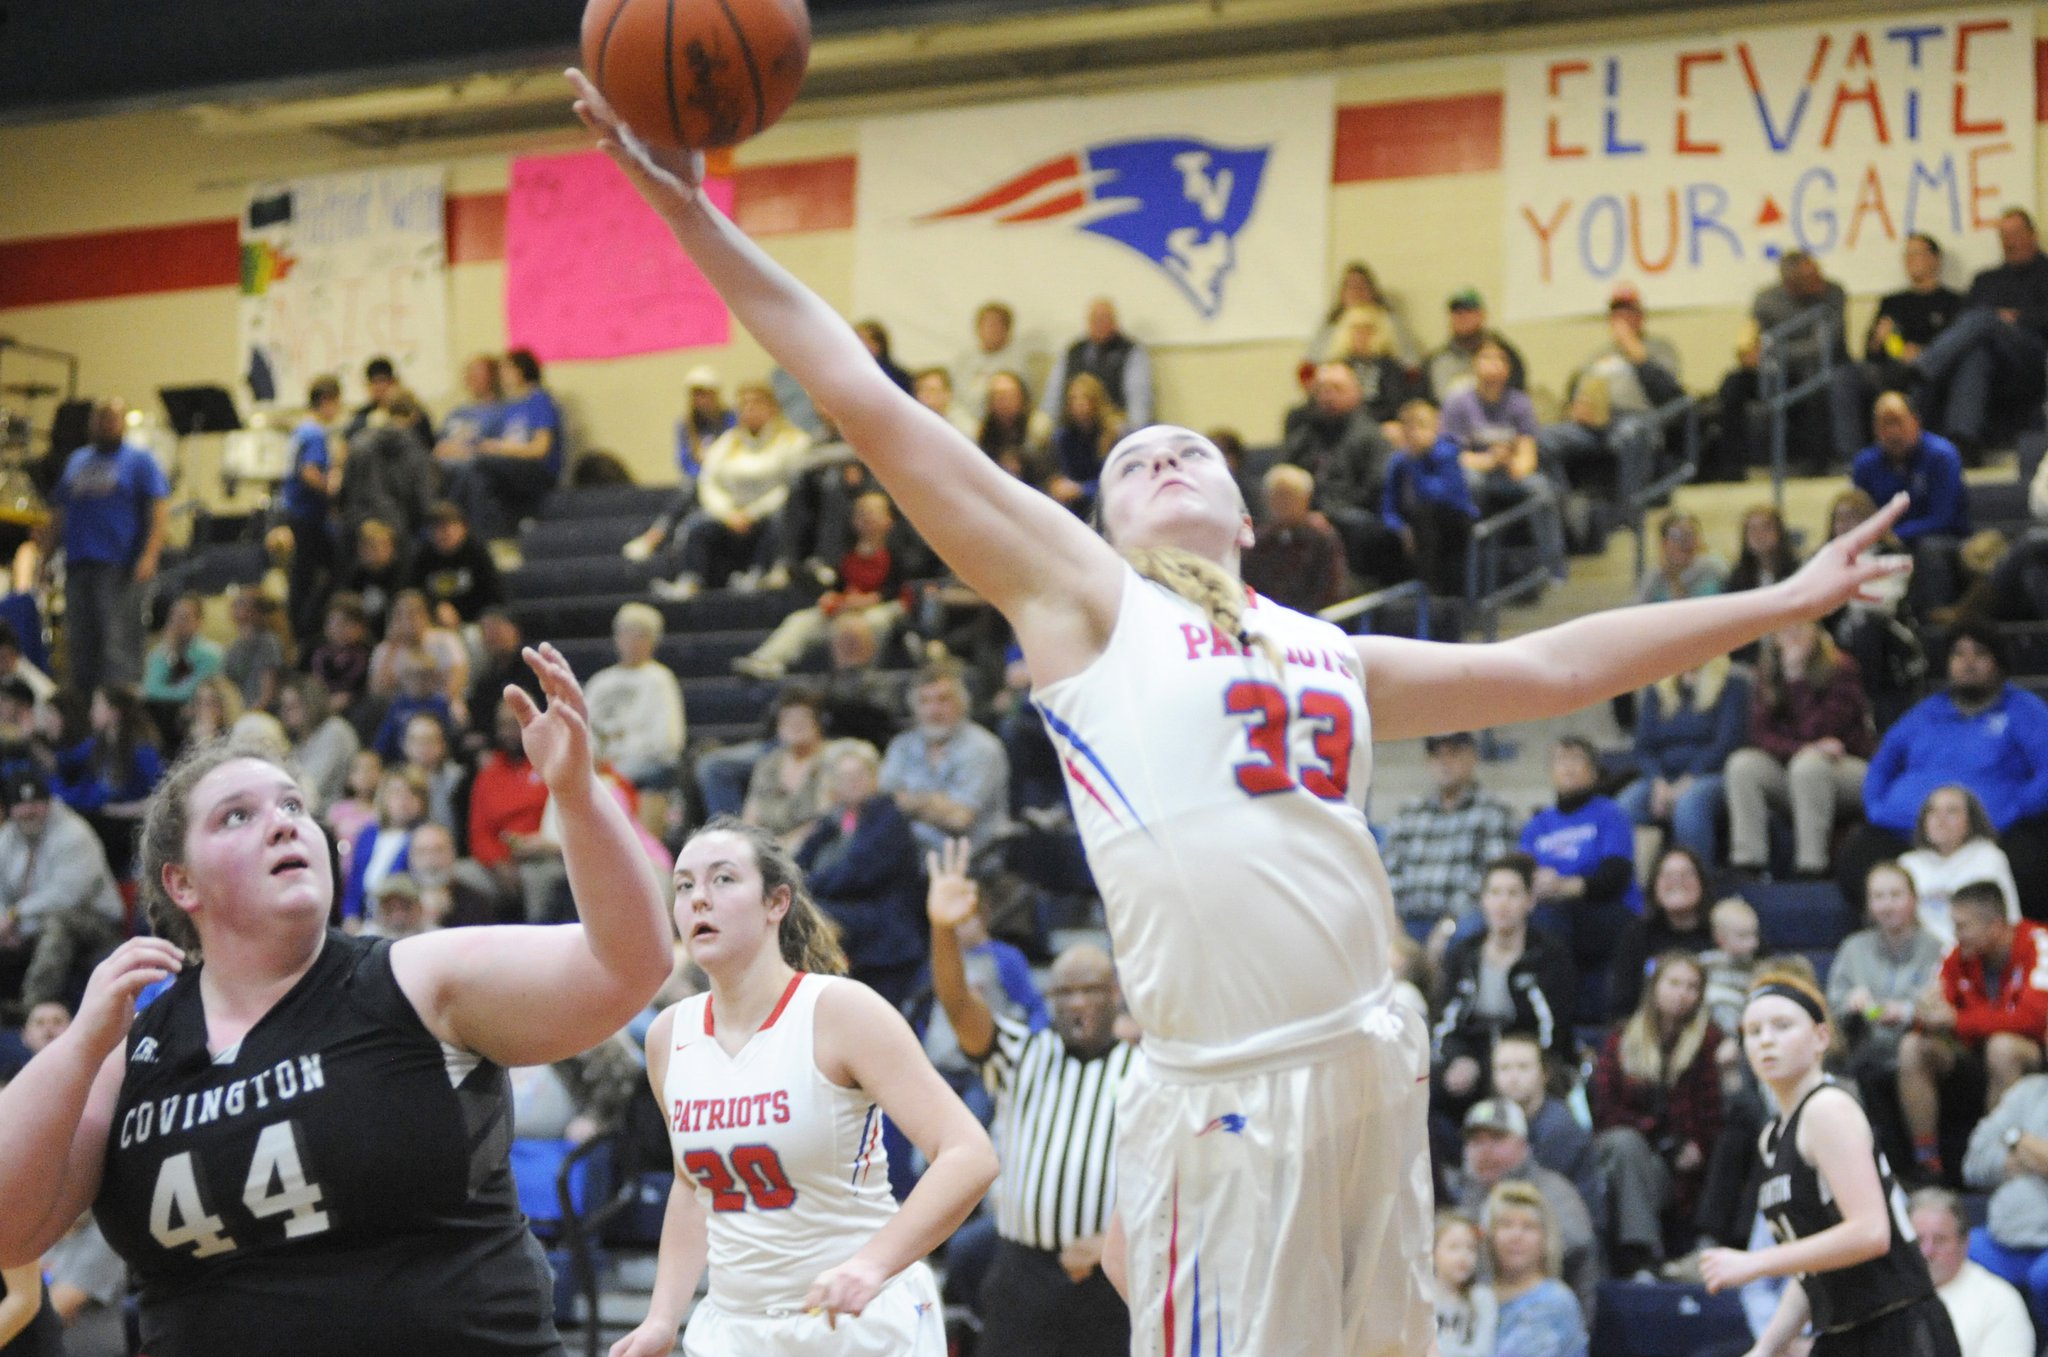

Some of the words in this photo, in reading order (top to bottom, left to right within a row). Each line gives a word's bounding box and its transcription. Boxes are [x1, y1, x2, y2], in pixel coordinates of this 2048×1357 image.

[1544, 20, 2012, 158] ELEVATE
[1520, 180, 1745, 284] YOUR
[1788, 142, 2013, 257] GAME
[1223, 678, 1354, 801] 33
[120, 1053, 325, 1149] COVINGTON
[672, 1089, 791, 1133] PATRIOTS
[149, 1119, 331, 1259] 44
[683, 1142, 797, 1213] 20
